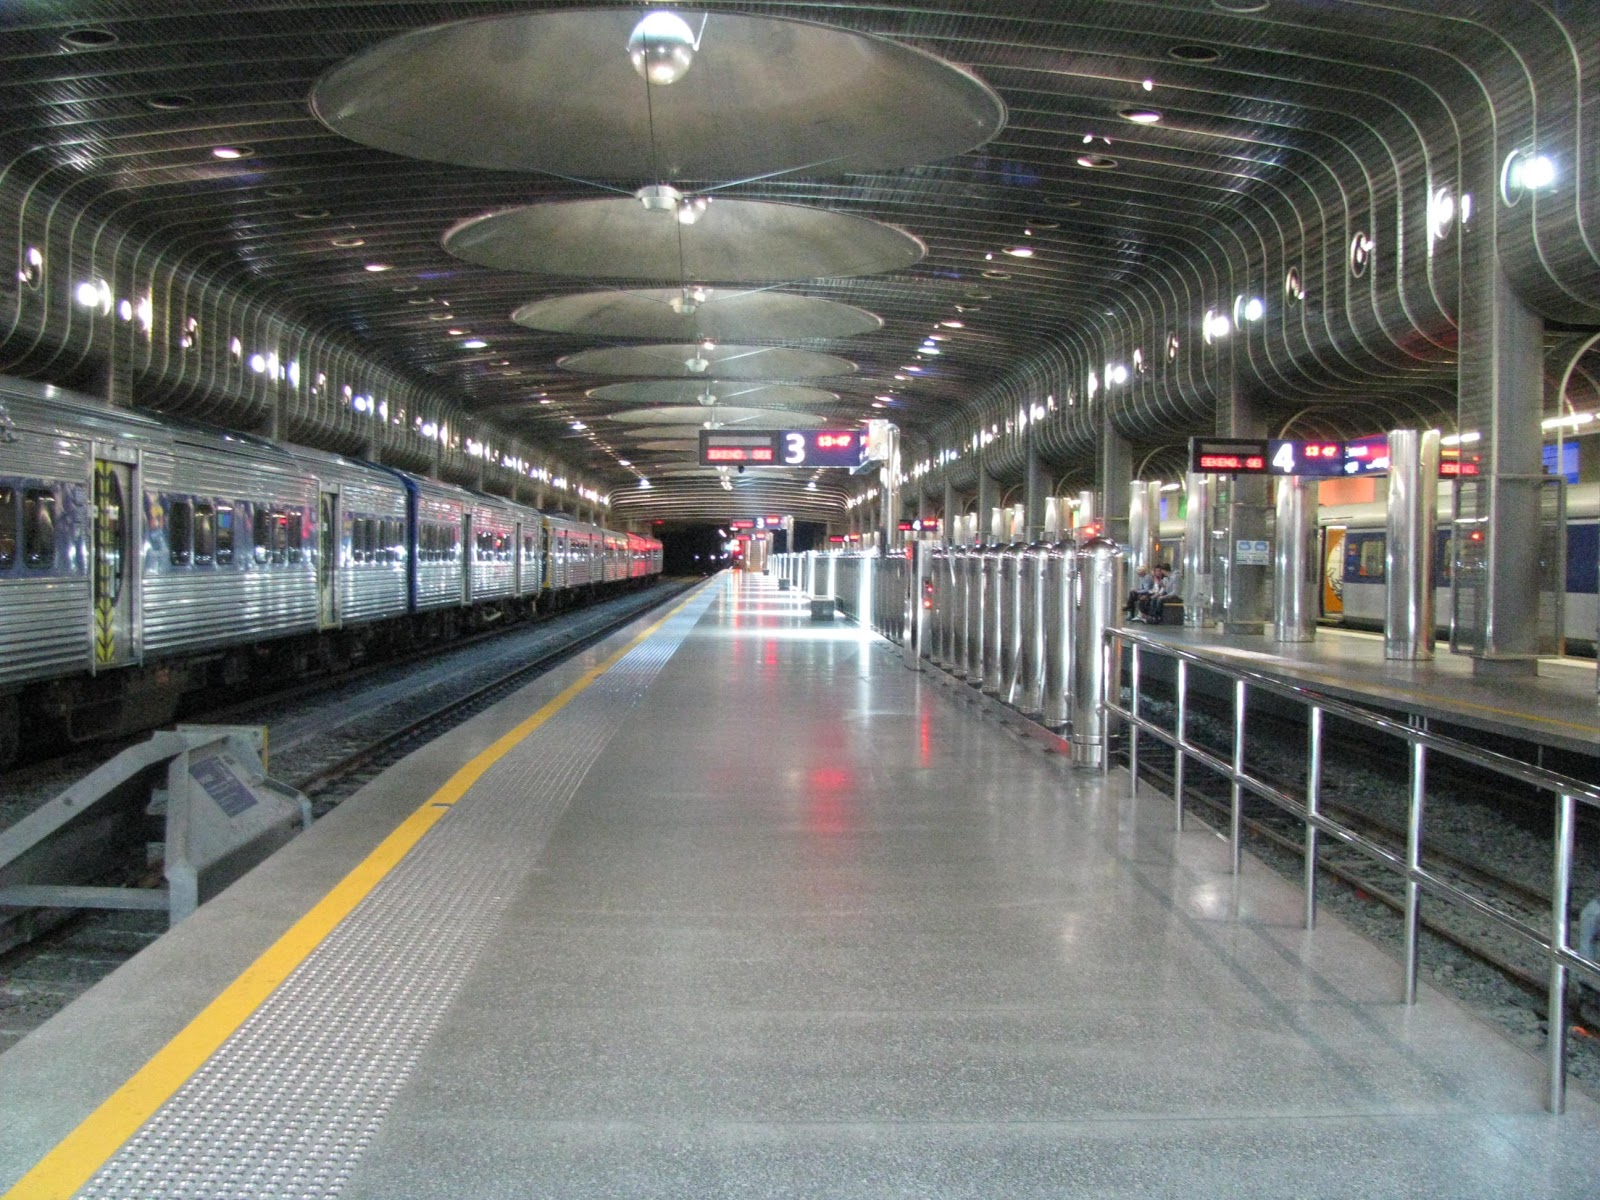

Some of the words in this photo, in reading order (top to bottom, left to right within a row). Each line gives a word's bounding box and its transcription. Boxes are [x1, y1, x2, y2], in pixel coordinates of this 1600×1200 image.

[785, 433, 805, 464] 3
[1272, 443, 1295, 473] 4
[756, 517, 765, 529] 3
